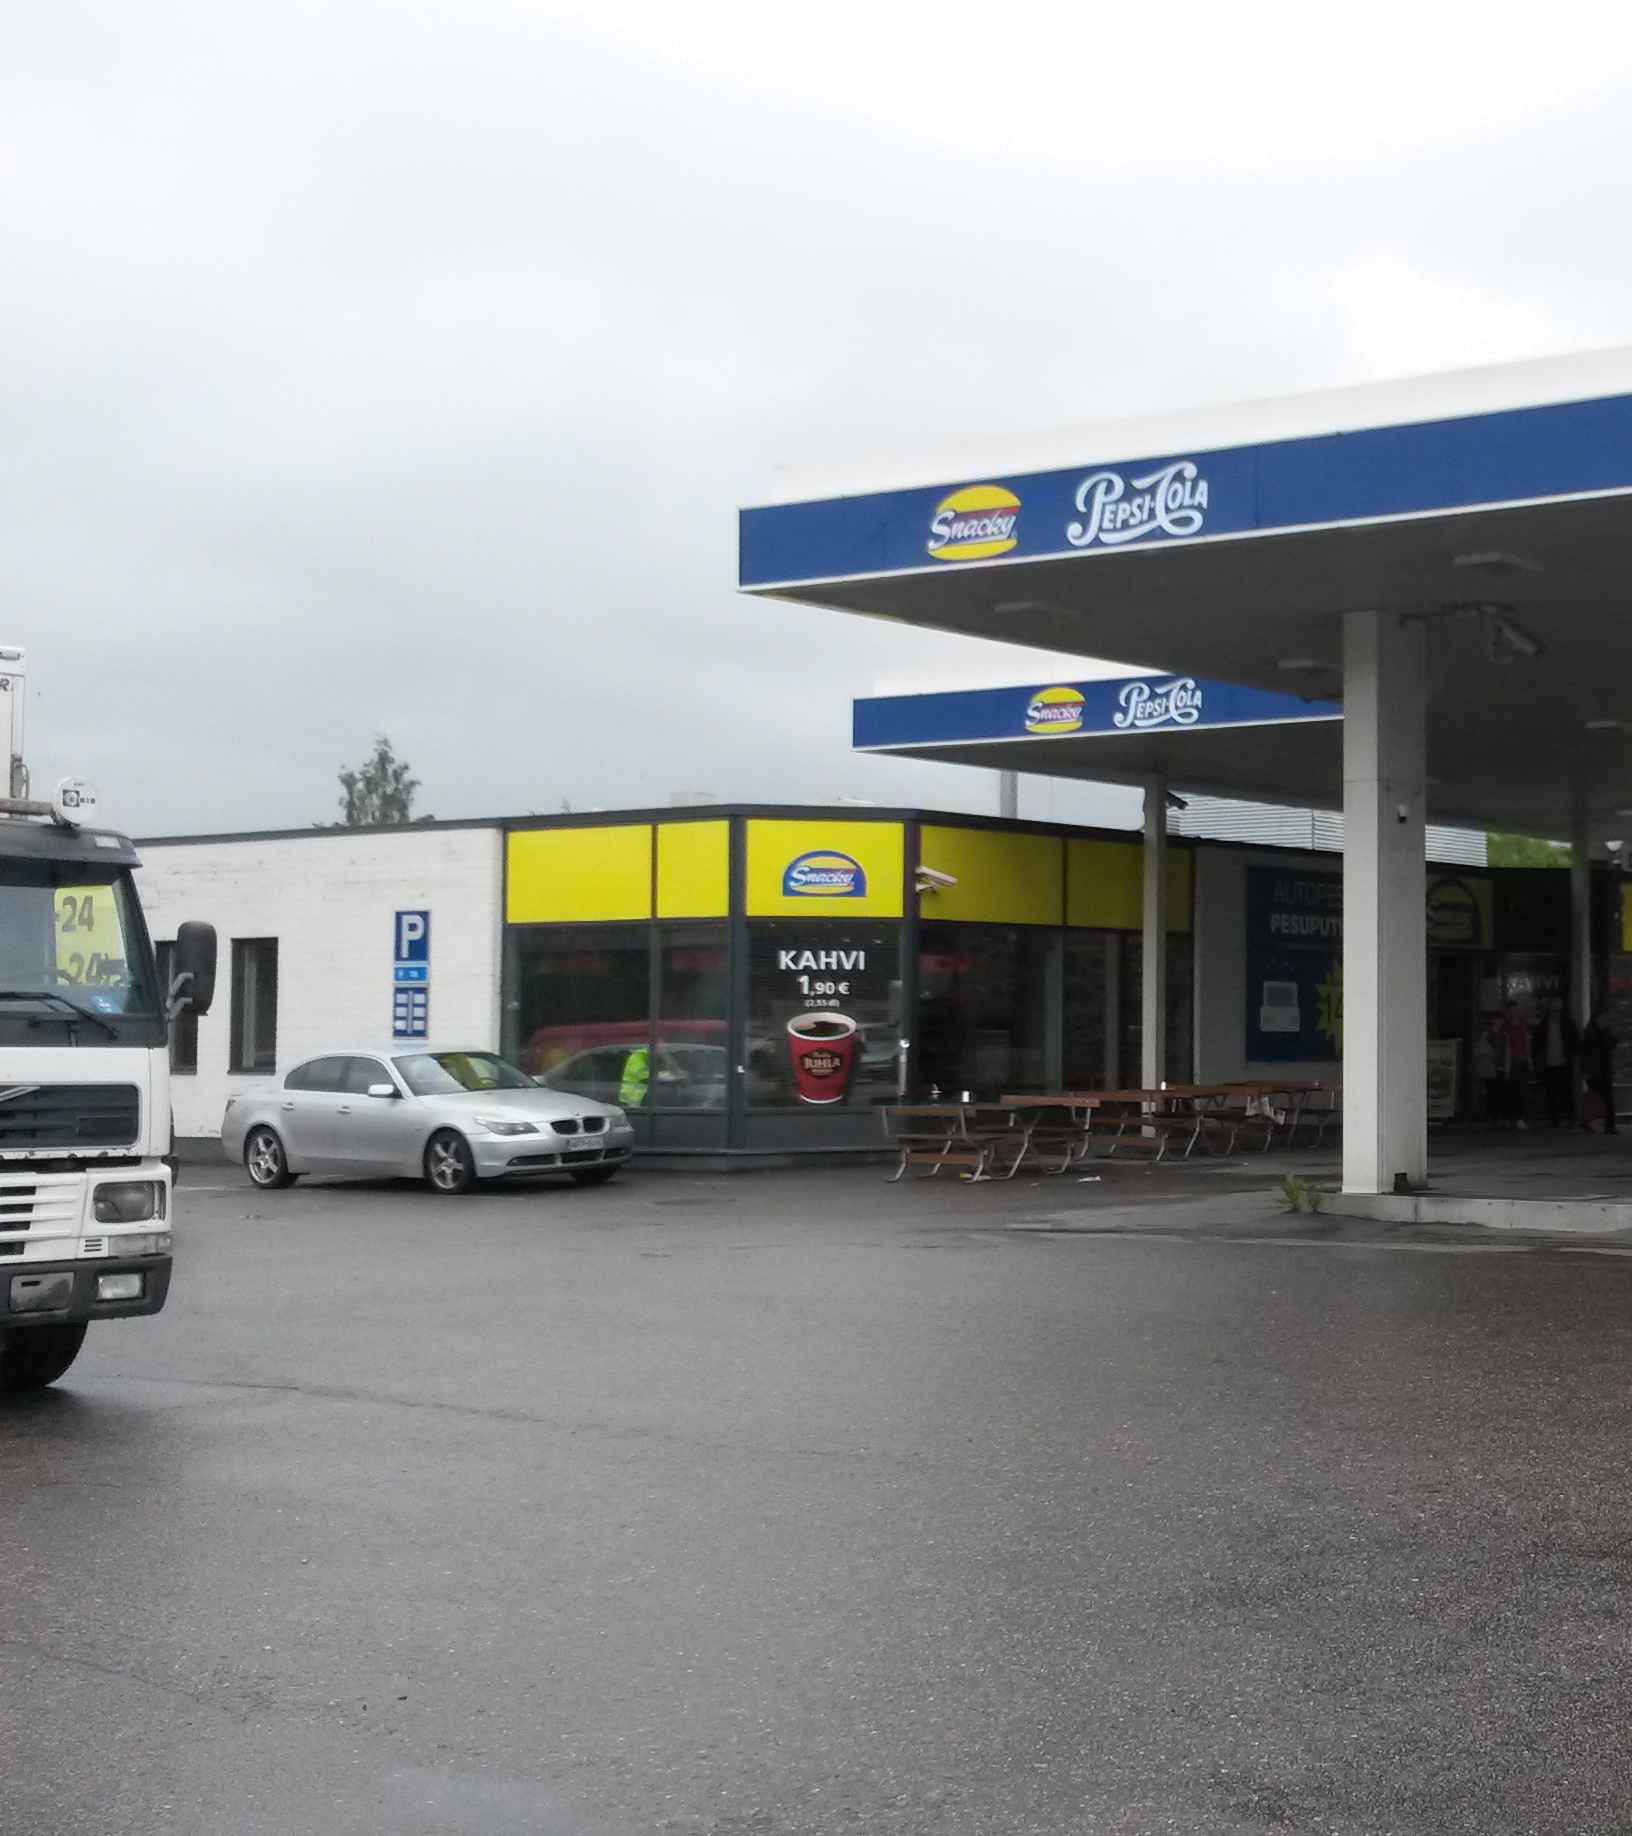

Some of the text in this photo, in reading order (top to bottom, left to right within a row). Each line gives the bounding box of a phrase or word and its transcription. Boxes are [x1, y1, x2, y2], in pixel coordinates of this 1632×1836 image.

[928, 508, 1017, 550] Snacky
[1025, 701, 1083, 726] Snacky
[789, 866, 855, 887] Snacky
[401, 914, 425, 959] P
[779, 950, 866, 971] KAHVI
[839, 982, 850, 995] €
[804, 1057, 841, 1069] JUHLA
